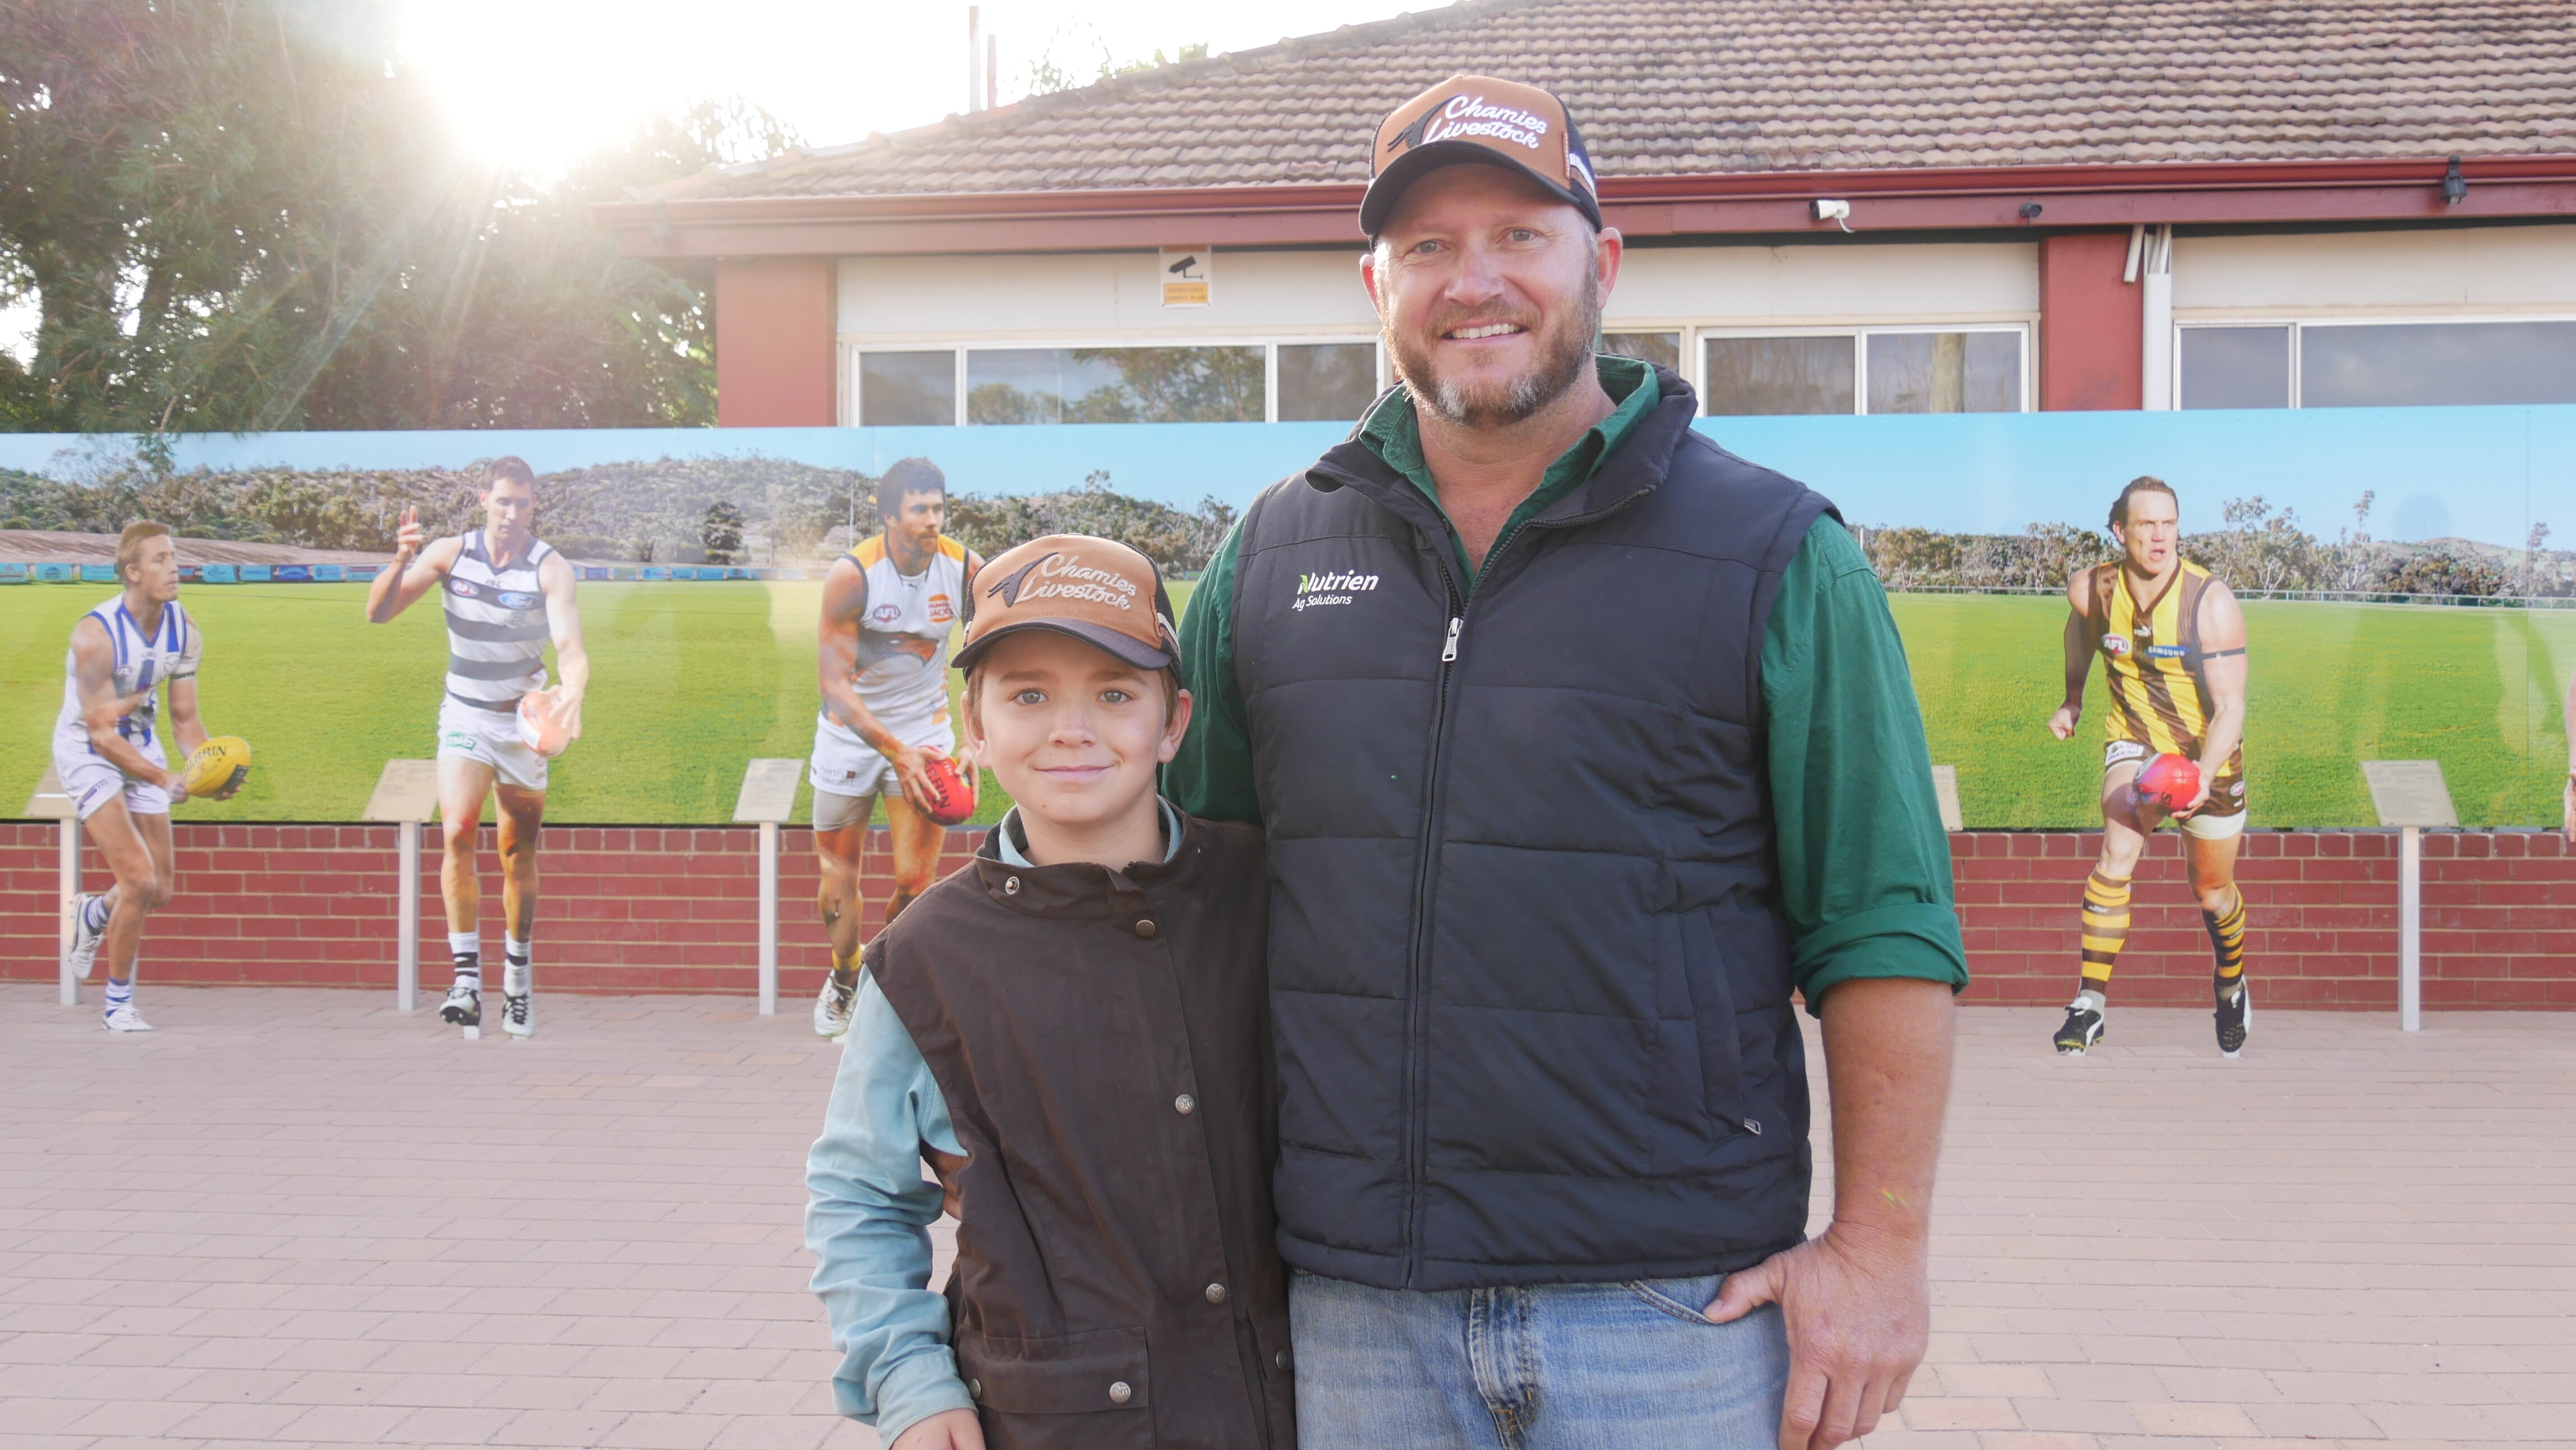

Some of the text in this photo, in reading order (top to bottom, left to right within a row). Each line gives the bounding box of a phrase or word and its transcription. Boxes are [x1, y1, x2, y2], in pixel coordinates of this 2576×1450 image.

[1445, 95, 1548, 135] Chamies
[1423, 117, 1540, 149] Livestock
[485, 579, 503, 588] ISC
[1041, 553, 1137, 597] Chamies
[1296, 570, 1379, 595] Nutrien
[1014, 575, 1131, 611] Livestock
[1292, 594, 1353, 612] Ag Solutions
[875, 607, 898, 618] AFL
[2104, 638, 2127, 652] AFL
[2148, 646, 2186, 657] SAMSUNG
